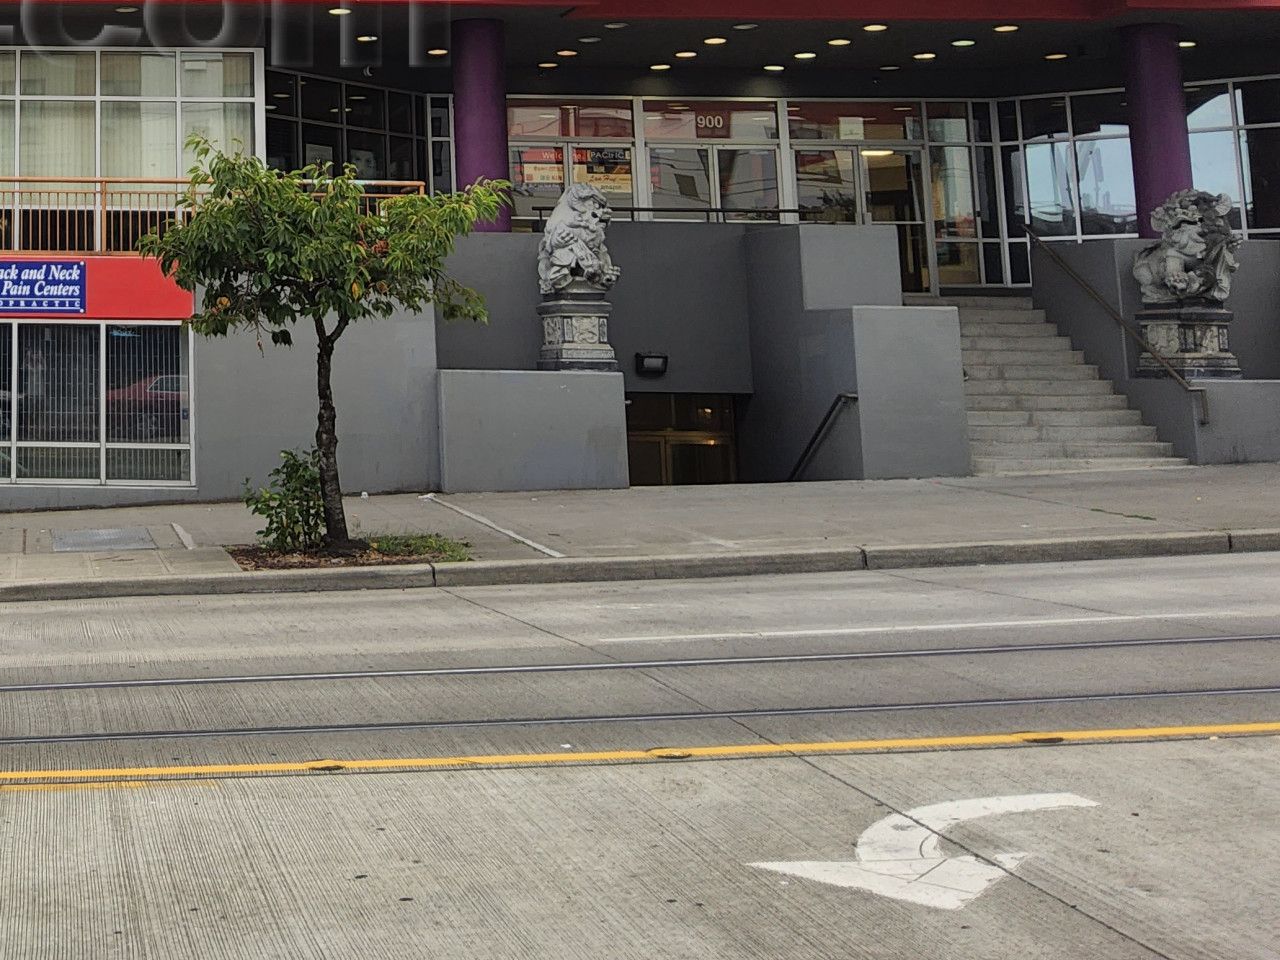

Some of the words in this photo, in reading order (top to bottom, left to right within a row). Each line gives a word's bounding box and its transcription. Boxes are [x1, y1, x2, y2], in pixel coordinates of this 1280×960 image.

[696, 115, 723, 128] 900
[21, 264, 45, 280] and
[48, 264, 81, 280] Neck
[1, 281, 31, 296] Pain
[34, 280, 81, 297] Centers
